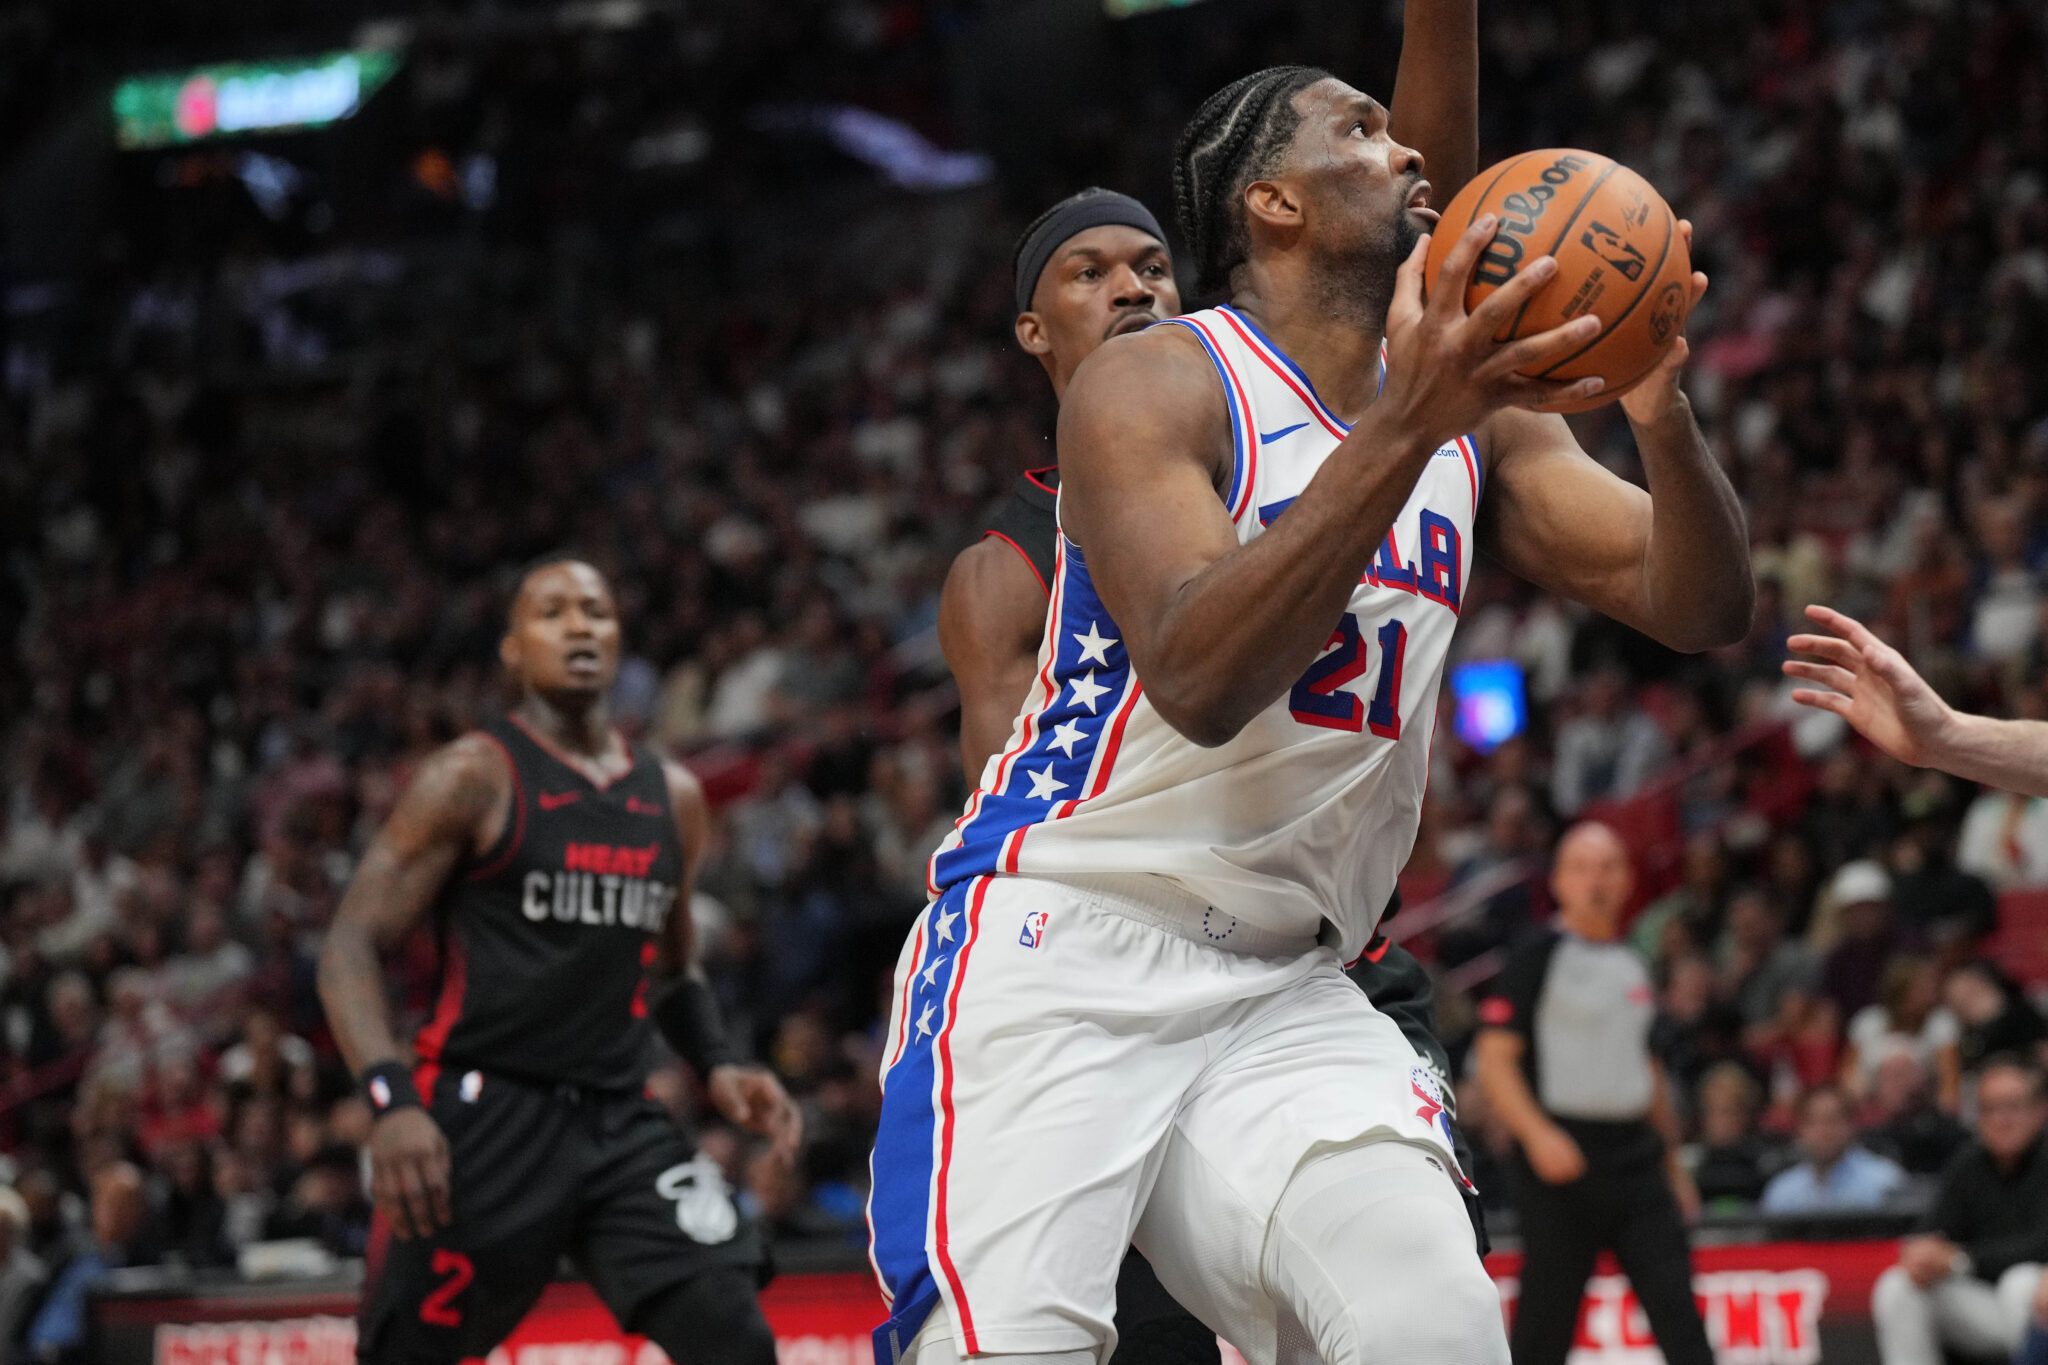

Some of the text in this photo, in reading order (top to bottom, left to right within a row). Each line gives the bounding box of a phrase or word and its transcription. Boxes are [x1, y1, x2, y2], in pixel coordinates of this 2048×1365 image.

[1289, 611, 1408, 741] 21
[564, 842, 661, 879] HEAT
[420, 1247, 475, 1328] 2
